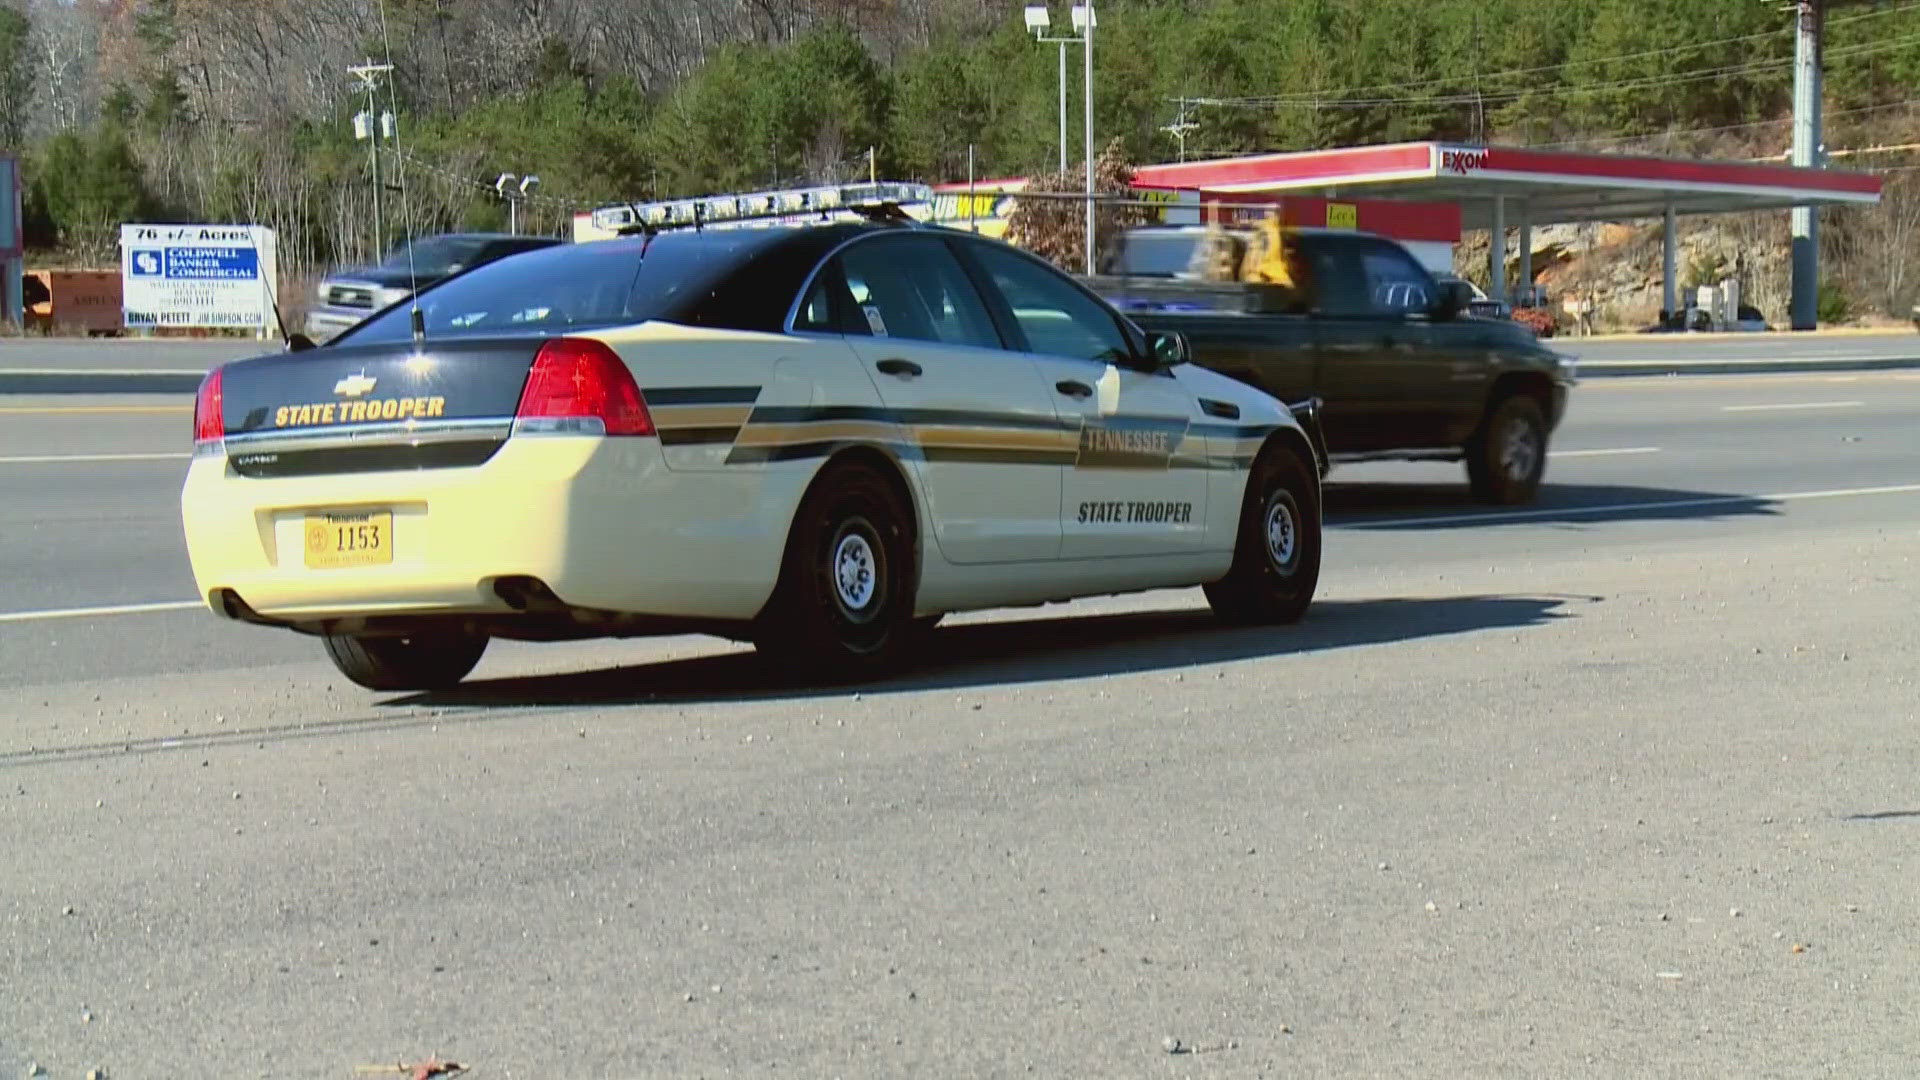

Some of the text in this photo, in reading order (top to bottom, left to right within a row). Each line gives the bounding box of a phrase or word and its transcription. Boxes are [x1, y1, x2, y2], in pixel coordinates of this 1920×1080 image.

[1442, 151, 1488, 175] EXXON
[921, 193, 994, 221] SUBWAY
[136, 229, 158, 241] 76
[199, 229, 249, 241] Acres
[169, 248, 239, 258] COLDWELL
[169, 258, 220, 267] BANKER
[169, 268, 255, 277] COMMERCIAL
[128, 312, 157, 324] BRYAN
[161, 312, 190, 323] PETETT
[211, 312, 241, 323] SIMPSON
[275, 396, 445, 428] STATE TROOPER
[1088, 430, 1169, 452] TENNESSEE
[1078, 501, 1192, 523] STATE TROOPER
[337, 525, 380, 551] 1153
